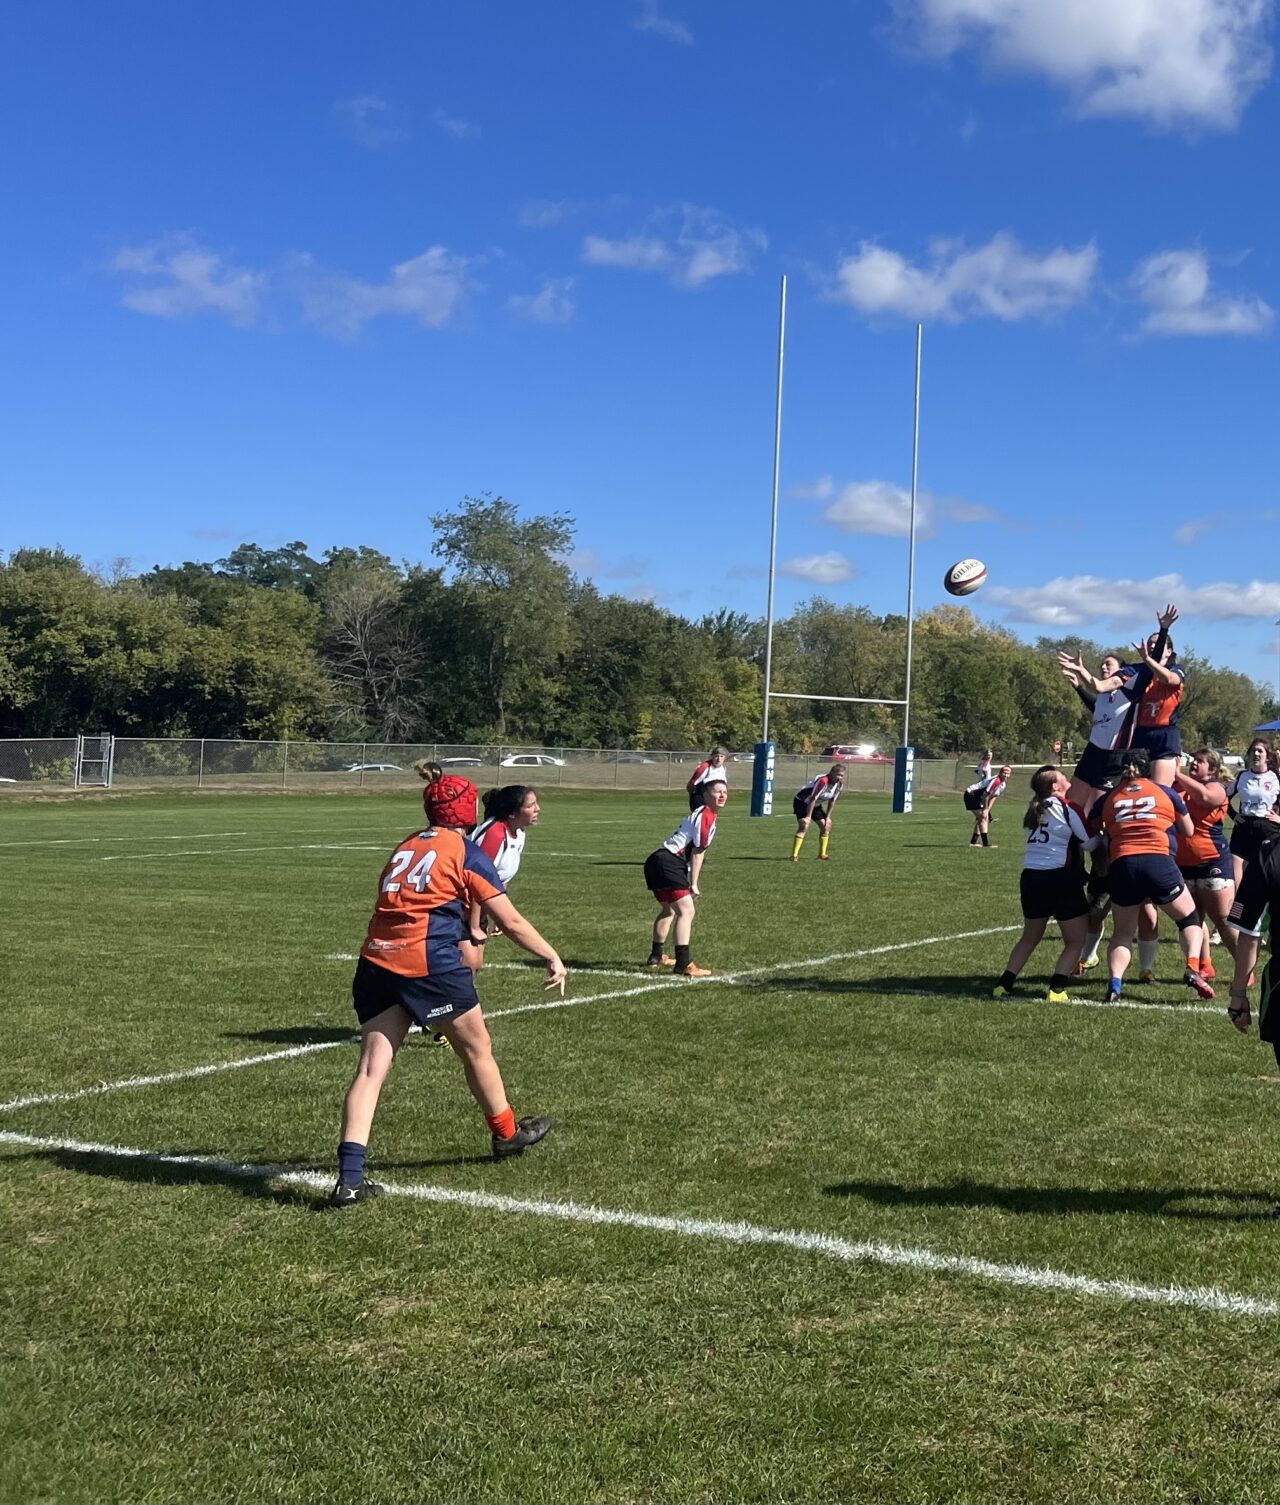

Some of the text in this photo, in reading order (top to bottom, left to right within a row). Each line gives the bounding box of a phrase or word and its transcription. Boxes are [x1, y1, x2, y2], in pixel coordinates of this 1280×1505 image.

[953, 561, 979, 580] GILBER
[763, 759, 775, 815] RHINO
[1113, 796, 1157, 823] 22
[1027, 822, 1050, 844] 25
[382, 850, 438, 893] 24
